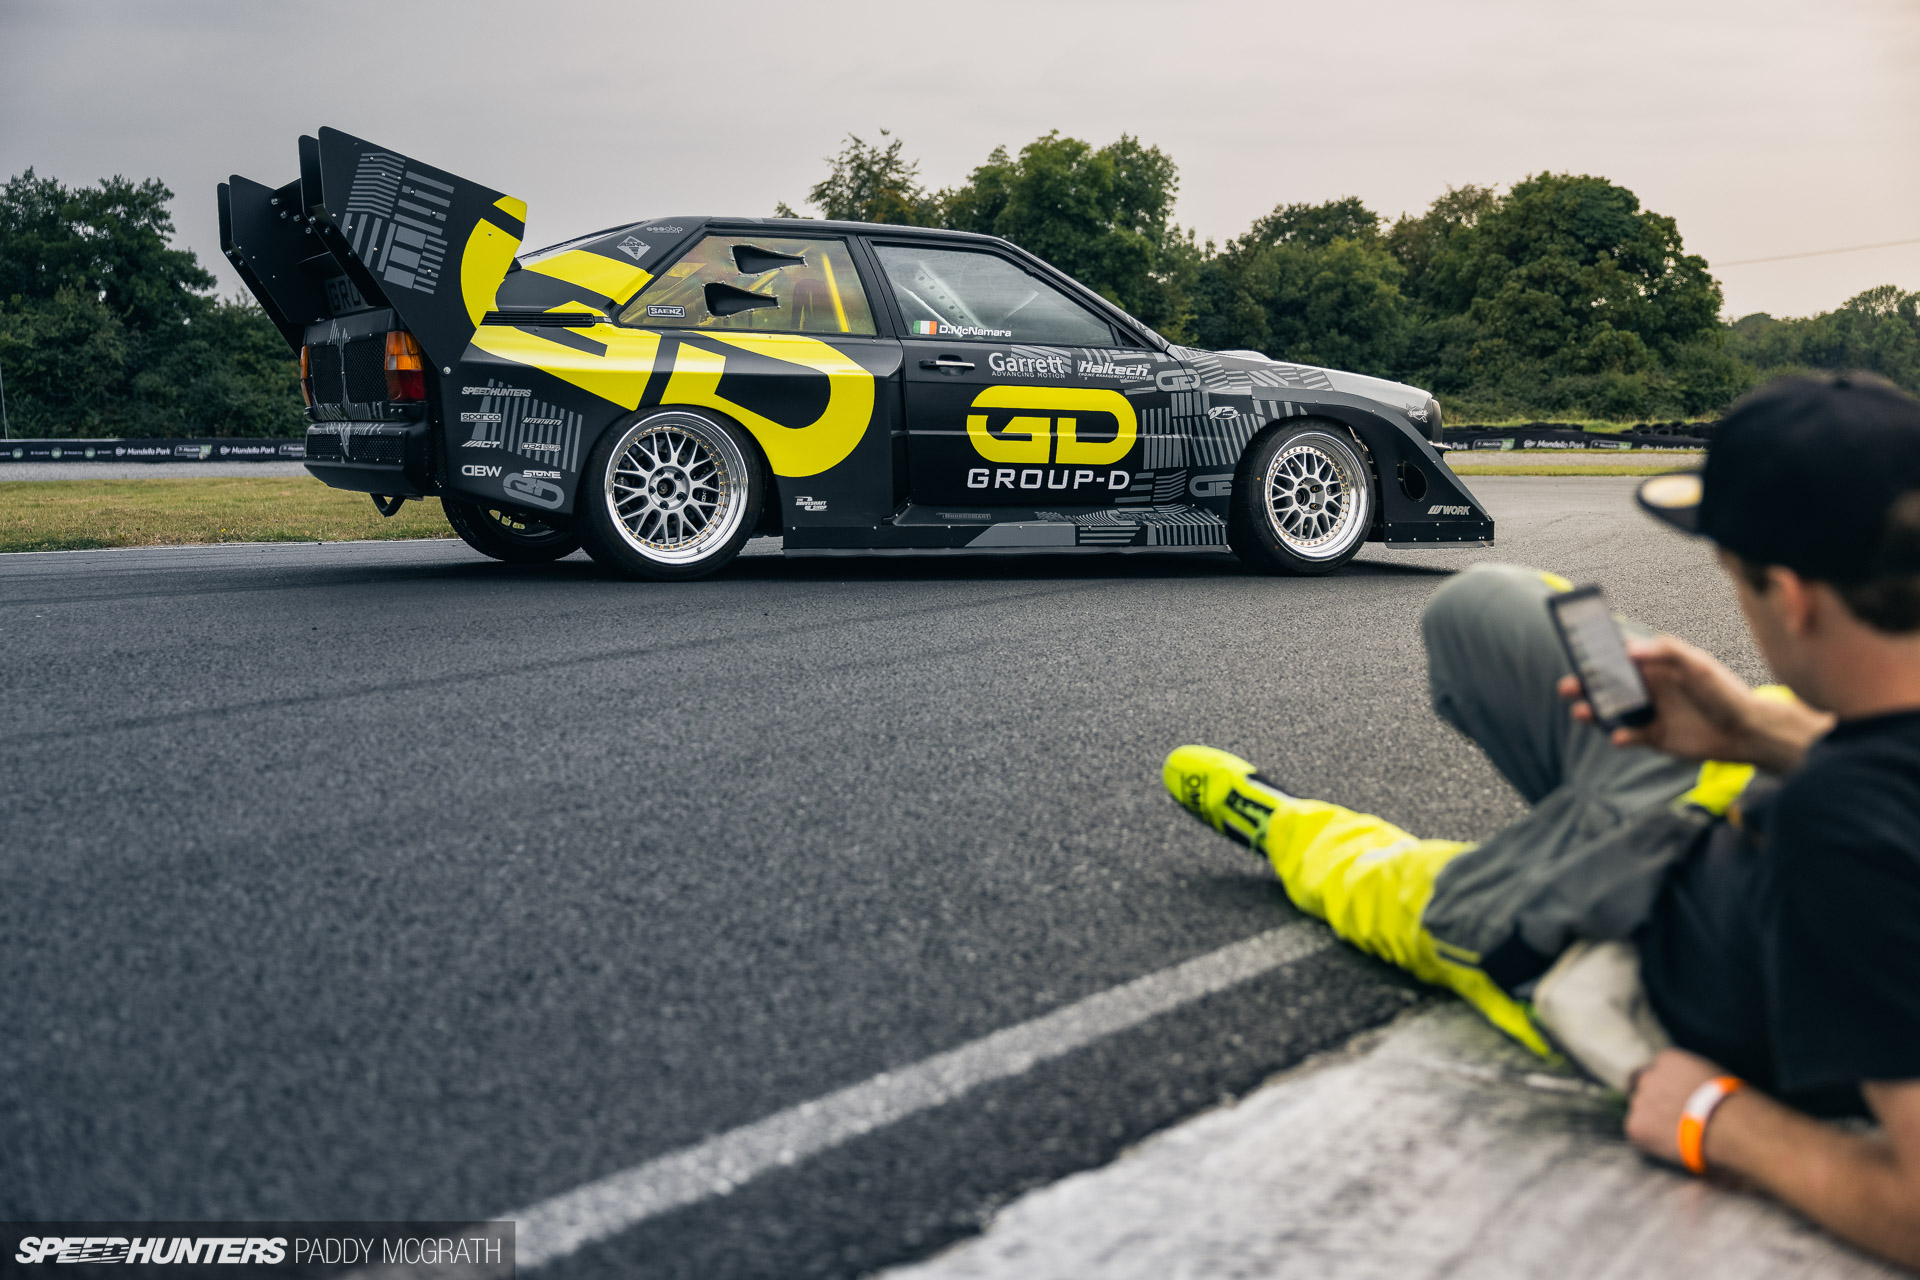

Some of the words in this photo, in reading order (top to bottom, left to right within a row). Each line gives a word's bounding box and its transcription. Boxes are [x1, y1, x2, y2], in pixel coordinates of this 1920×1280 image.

[650, 307, 682, 316] SAENZ
[939, 325, 1012, 338] D.McNamara
[988, 352, 1063, 374] Garrett
[1079, 361, 1148, 377] Haltech
[462, 386, 532, 397] SPEEDHUNTERS
[462, 413, 500, 422] sparco
[967, 385, 1138, 465] GD
[1569, 441, 1586, 449] Park
[155, 447, 171, 455] Park
[522, 469, 561, 479] STONE
[967, 468, 1130, 490] GROUP-D
[1442, 505, 1471, 515] WORK
